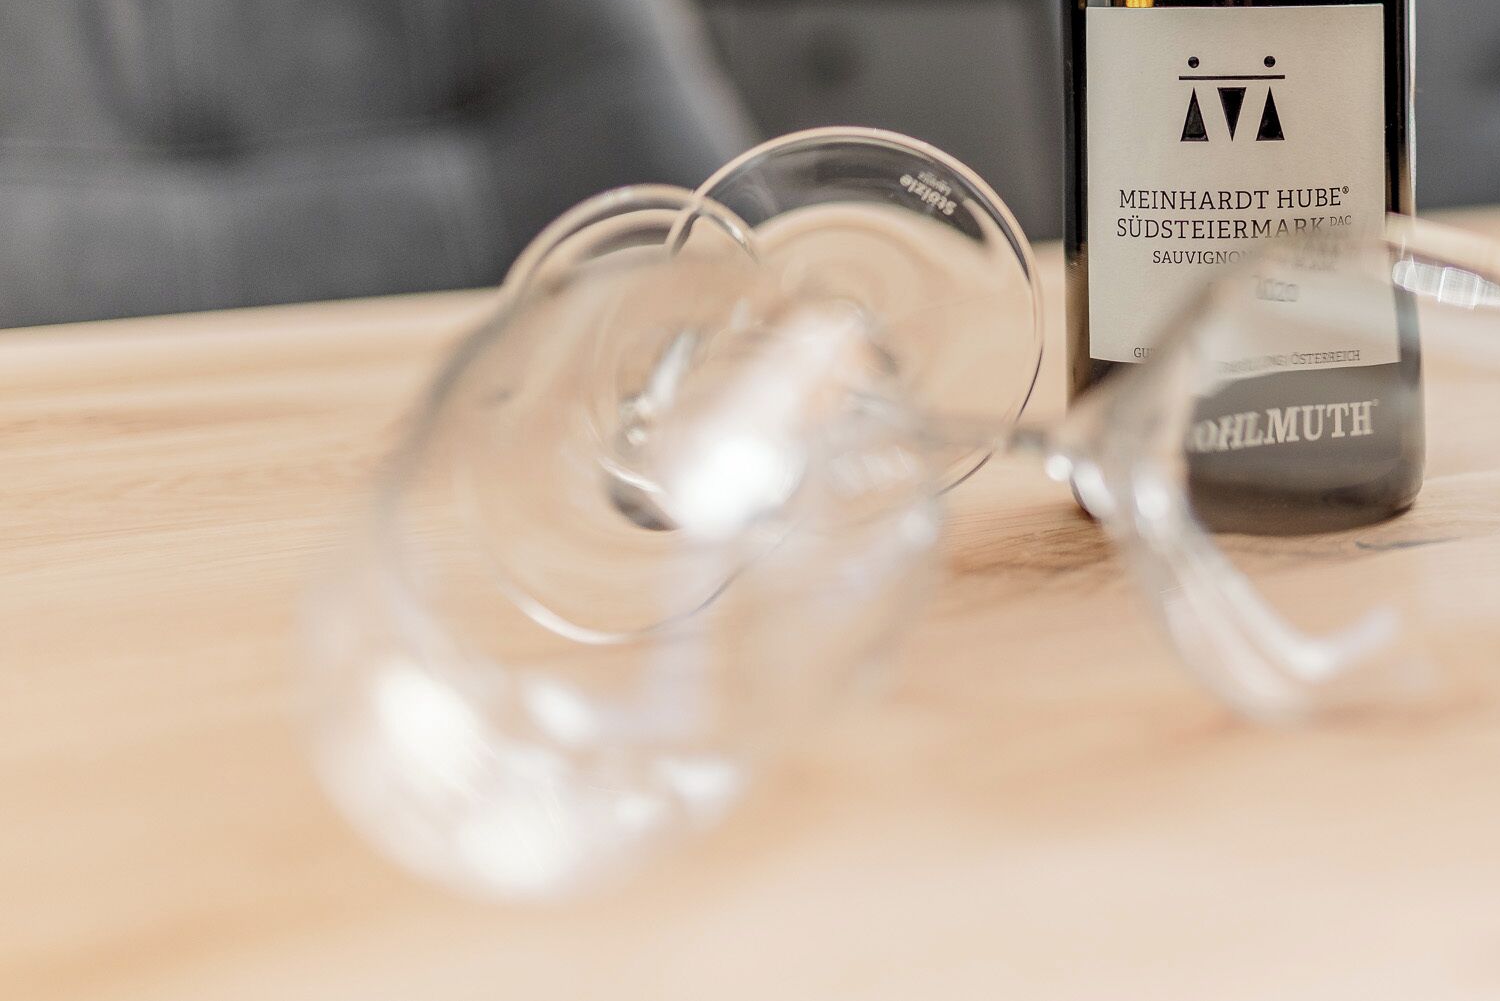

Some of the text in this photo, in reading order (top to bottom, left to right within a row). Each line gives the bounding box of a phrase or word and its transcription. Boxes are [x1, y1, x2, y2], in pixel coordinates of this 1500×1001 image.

[1118, 189, 1270, 211] MEINHARDT
[1116, 214, 1353, 240] SÜDSTEIERMARK DAC
[1291, 349, 1361, 366] ÖSTERREICH
[1192, 399, 1376, 454] OHLMUTH
